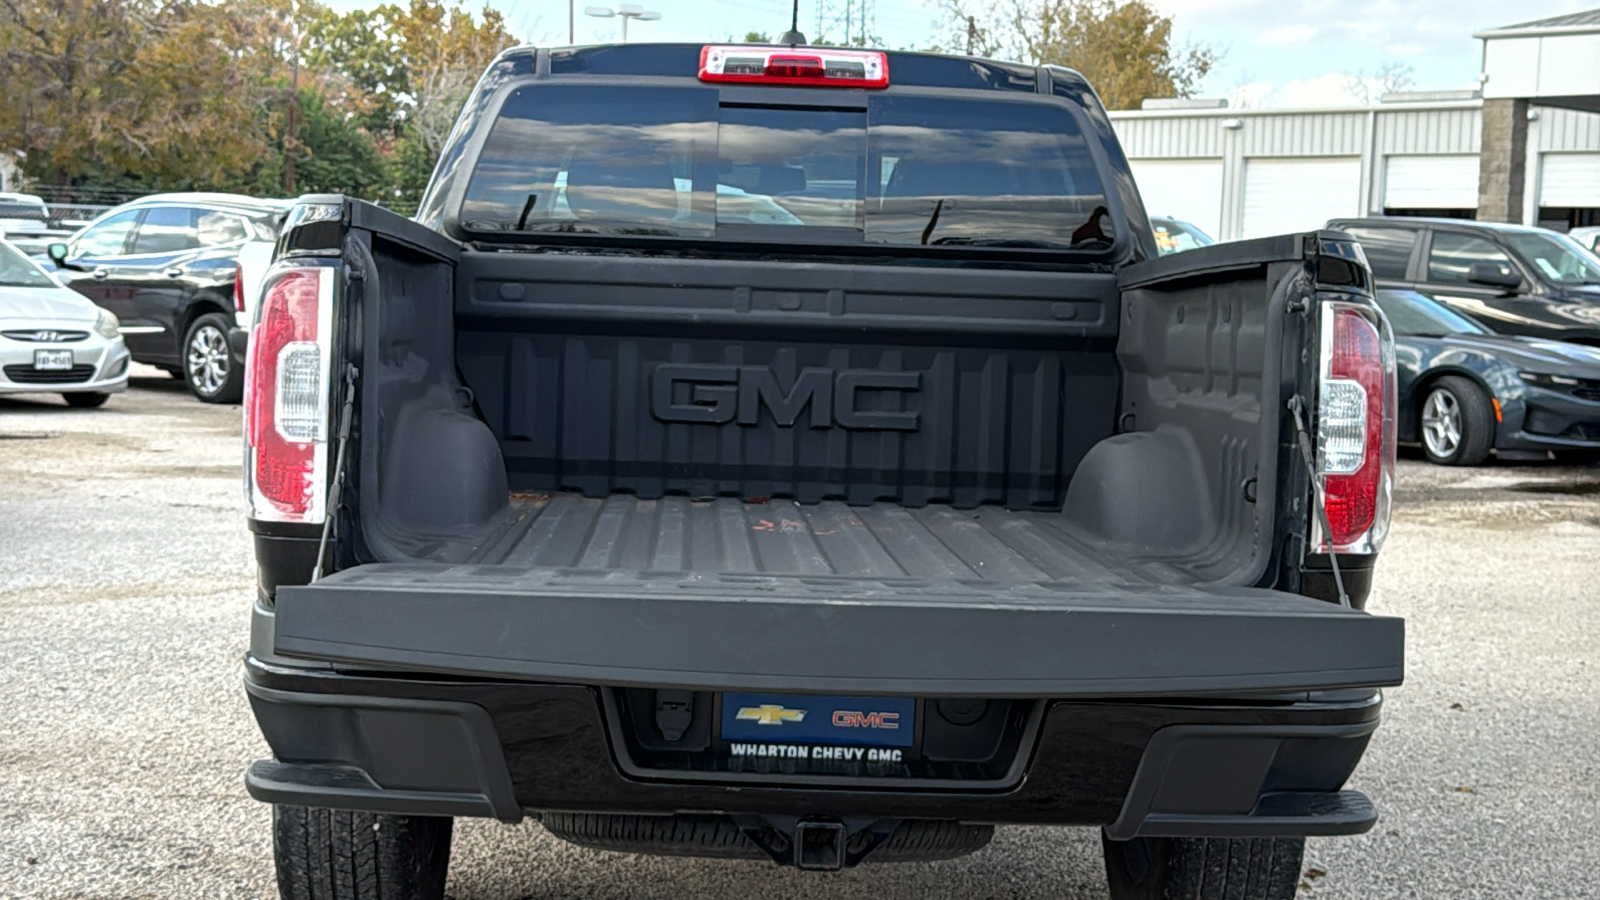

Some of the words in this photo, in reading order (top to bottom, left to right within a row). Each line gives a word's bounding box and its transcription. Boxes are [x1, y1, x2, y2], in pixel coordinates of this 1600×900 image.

[651, 362, 922, 433] GMC
[832, 710, 899, 729] GMC
[731, 743, 809, 758] WHARTON
[812, 746, 865, 761] CHEVY
[867, 748, 902, 762] GMC
